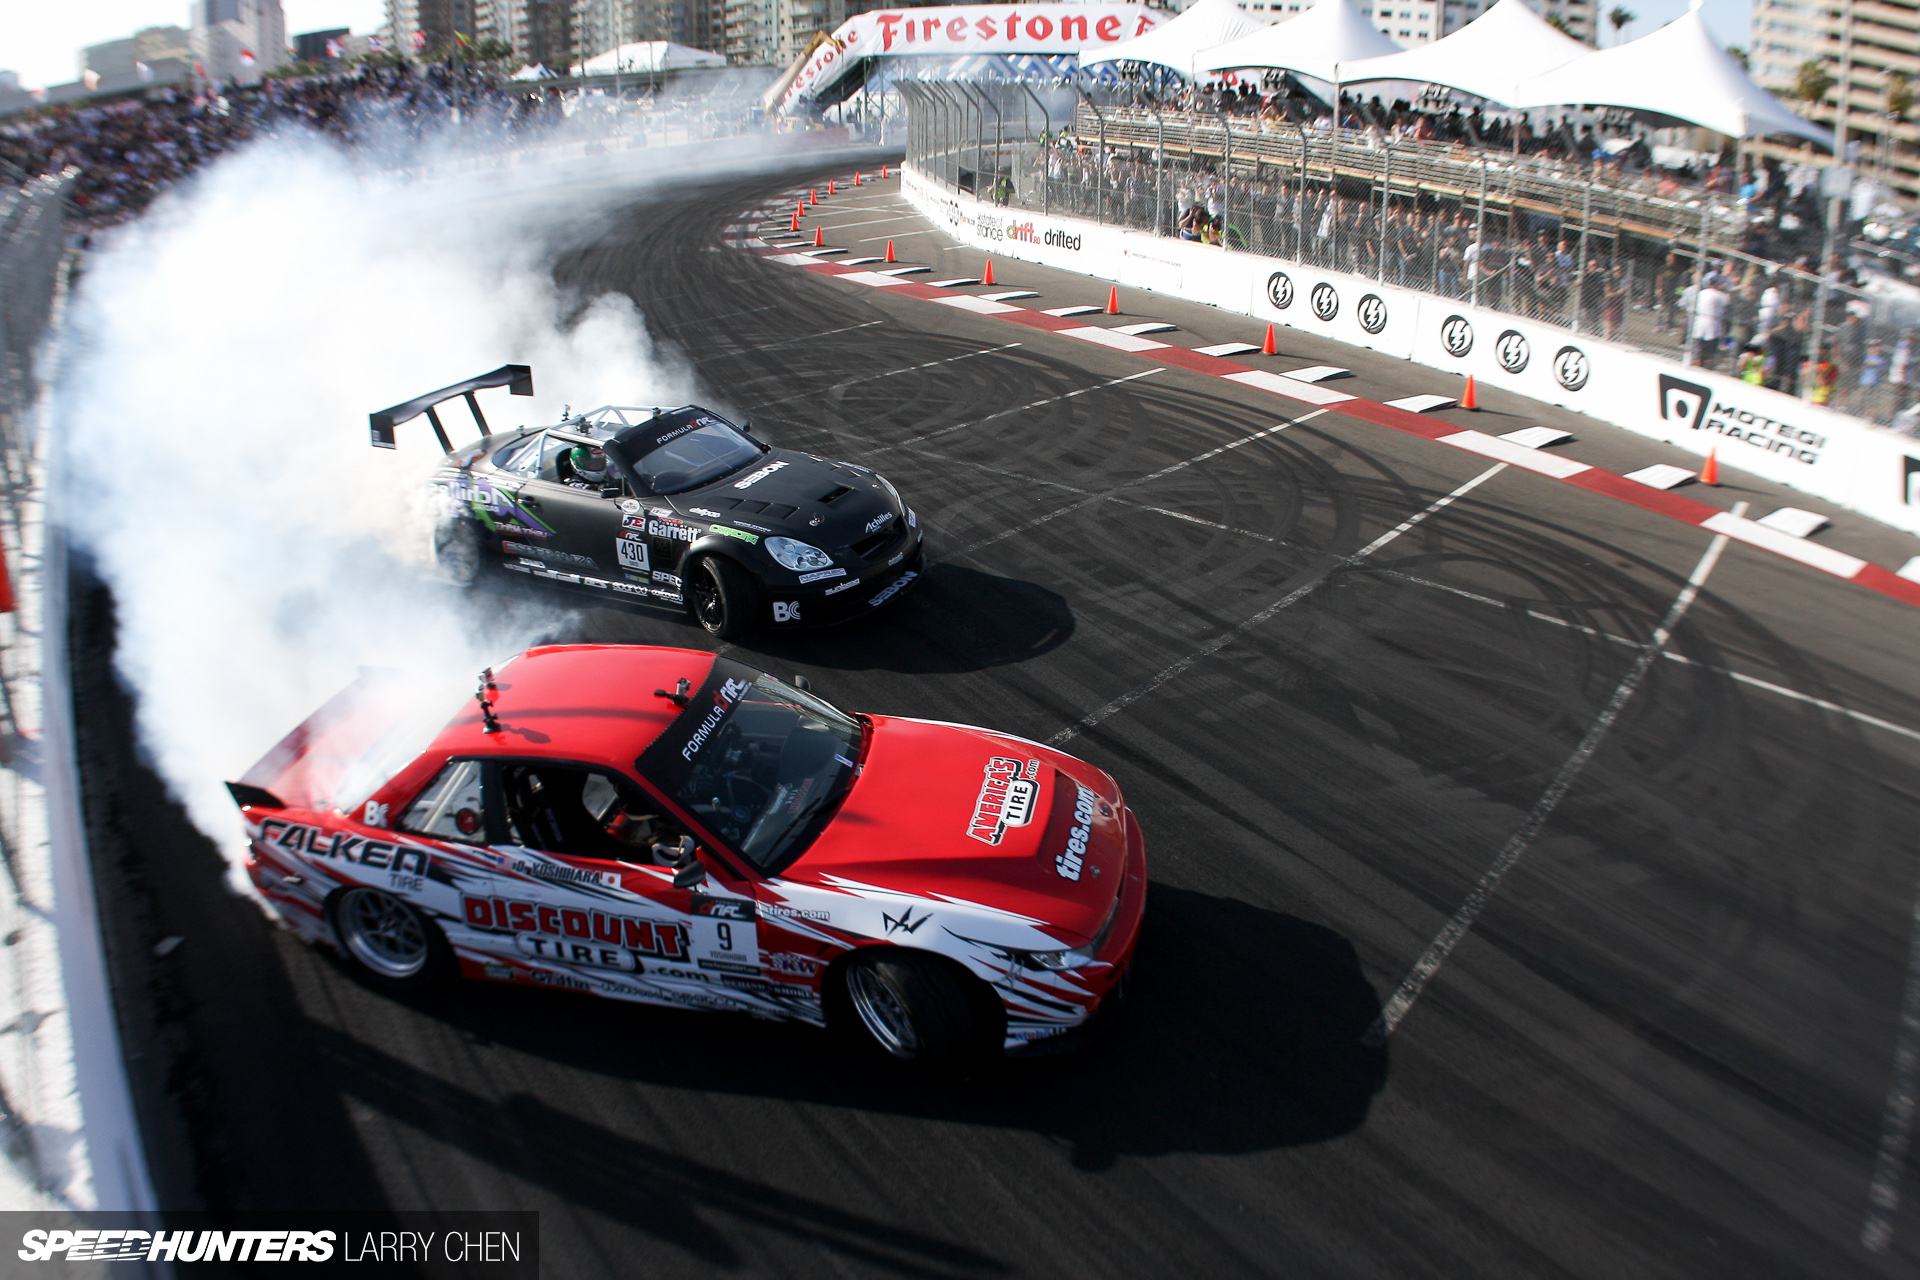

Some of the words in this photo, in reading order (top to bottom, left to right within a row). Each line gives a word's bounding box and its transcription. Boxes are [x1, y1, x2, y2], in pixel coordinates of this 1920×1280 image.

[876, 12, 1122, 51] Firestone
[977, 222, 1003, 242] stance
[1044, 228, 1081, 251] drifted
[656, 425, 694, 445] FORMULA
[1712, 403, 1827, 448] MOTEGI
[1705, 418, 1818, 465] RACING
[649, 519, 700, 543] Garrett
[864, 511, 893, 534] Achilles
[621, 541, 644, 562] 430
[652, 570, 683, 588] SPEC
[681, 705, 726, 761] FORMULA
[968, 758, 1017, 844] AMERICA'S
[1005, 785, 1029, 820] TIRE
[1055, 784, 1097, 882] tires.com
[260, 817, 430, 877] FALKEN
[388, 872, 424, 892] TIRE
[530, 863, 602, 885] YOSHIHARA
[769, 904, 831, 921] tires.com
[462, 893, 689, 962] DISCOUNT
[716, 922, 733, 951] 9
[525, 936, 624, 968] TIRE
[709, 950, 748, 962] YOSHIHARA
[650, 965, 710, 983] .com
[781, 958, 819, 974] KW
[529, 969, 592, 992] Griffin
